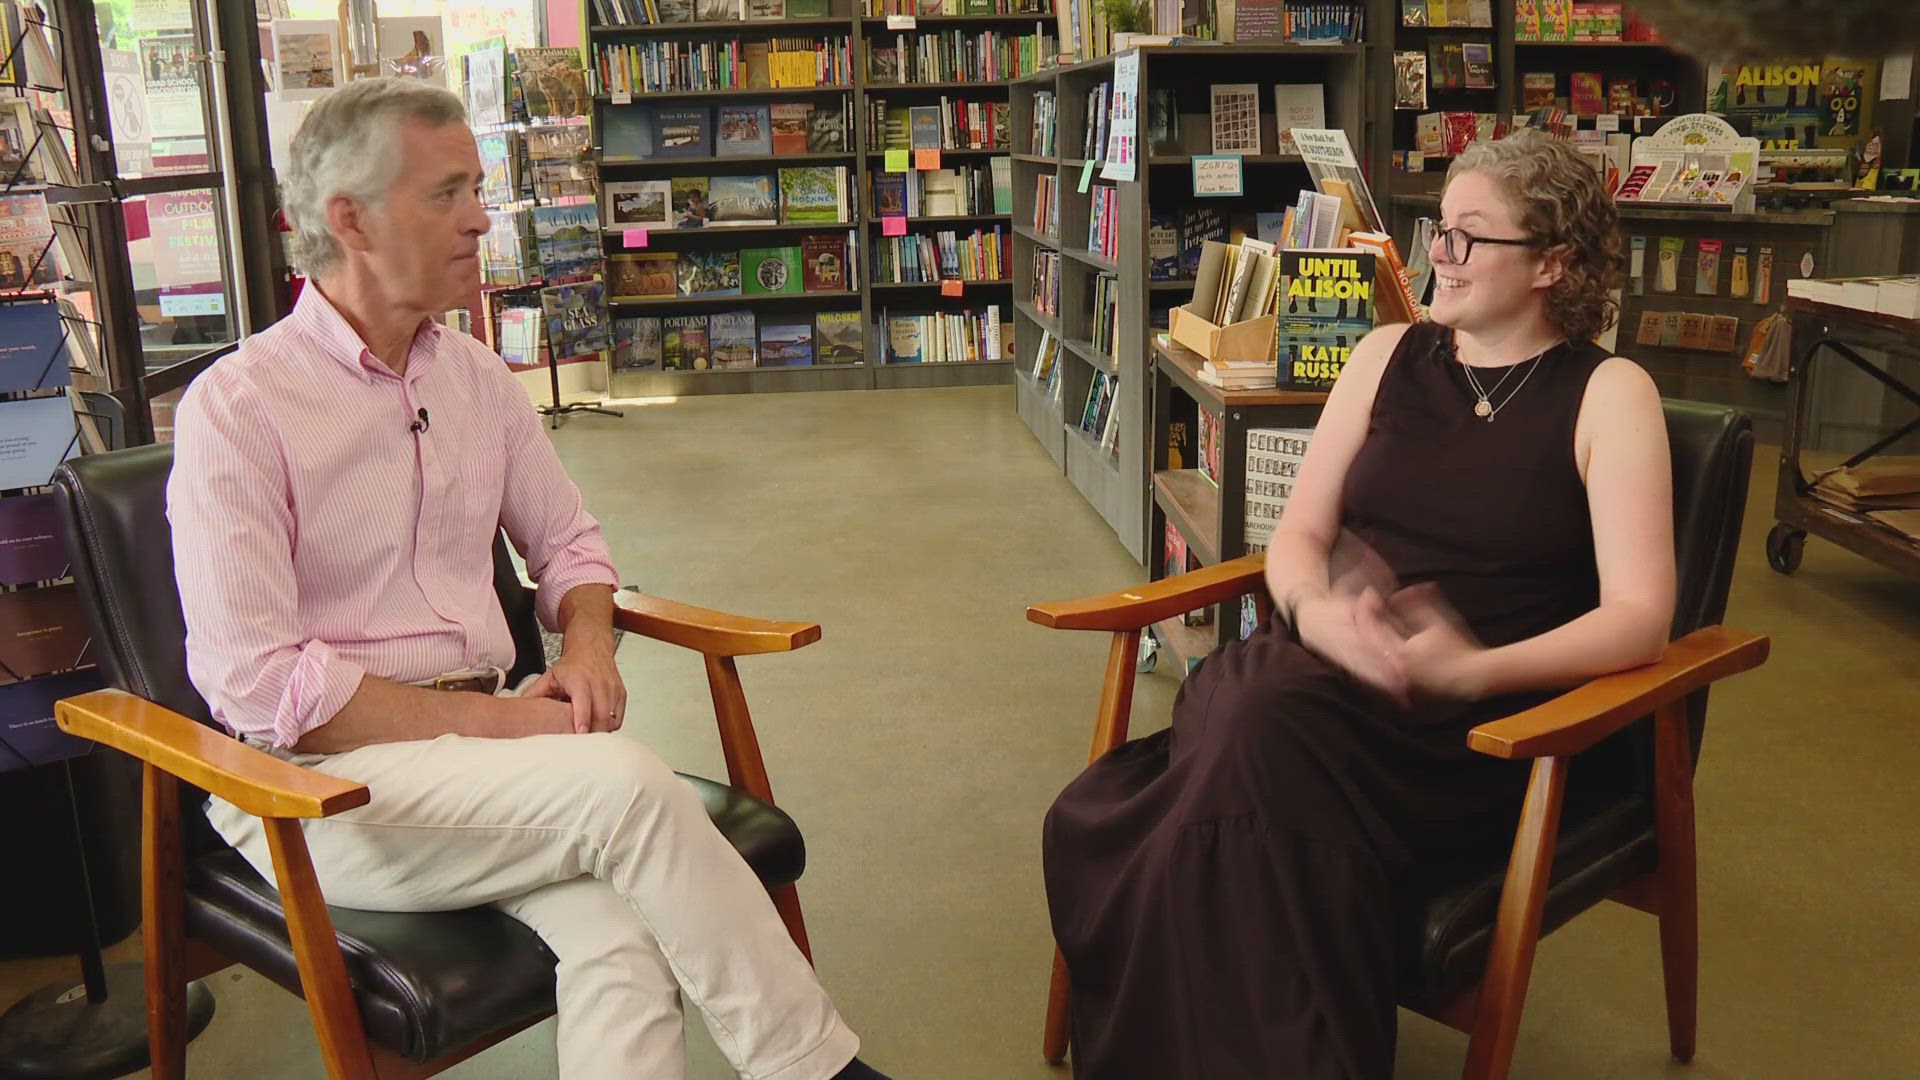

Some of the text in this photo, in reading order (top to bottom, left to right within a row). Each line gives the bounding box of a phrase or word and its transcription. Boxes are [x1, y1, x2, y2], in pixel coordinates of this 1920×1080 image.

[520, 48, 578, 57] BABY ANIMALS
[1736, 64, 1820, 86] ALISON
[167, 78, 198, 86] SCHOOL
[1691, 122, 1724, 136] STICKERS
[1760, 139, 1799, 150] ATE
[546, 212, 590, 228] ACADIA
[168, 235, 217, 248] FESTIV
[1298, 258, 1361, 278] UNTIL
[1398, 269, 1409, 286] NO
[1288, 279, 1370, 300] ALISON
[568, 306, 588, 319] SEA
[820, 313, 859, 323] WILDSAM
[564, 316, 598, 331] GLASS
[616, 318, 659, 329] PORTLAND
[664, 316, 708, 327] PORTLAND
[711, 314, 755, 325] PORTLAND
[1302, 345, 1350, 362] KATE
[1294, 362, 1341, 378] RUSS
